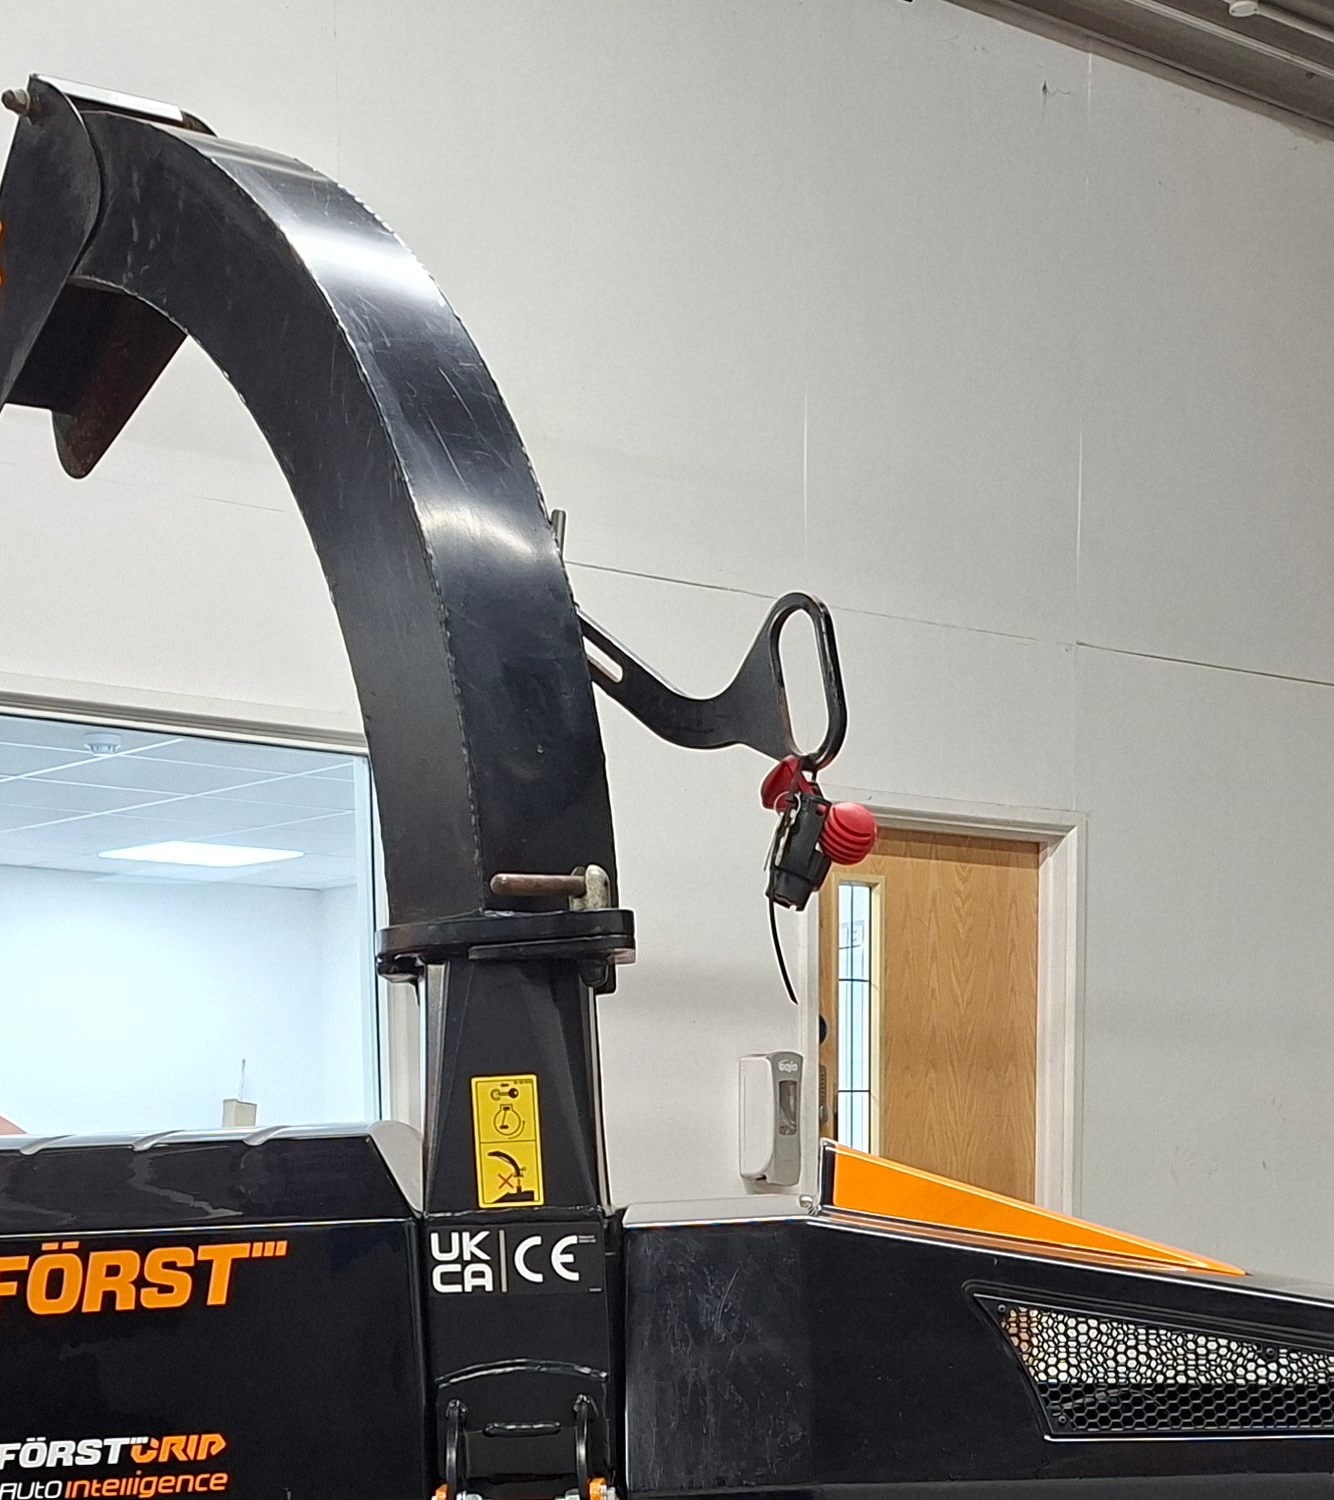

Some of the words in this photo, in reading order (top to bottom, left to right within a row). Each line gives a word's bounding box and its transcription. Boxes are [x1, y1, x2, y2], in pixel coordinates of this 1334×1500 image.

[430, 1230, 492, 1262] UK
[514, 1234, 581, 1284] CE
[432, 1263, 494, 1293] CA
